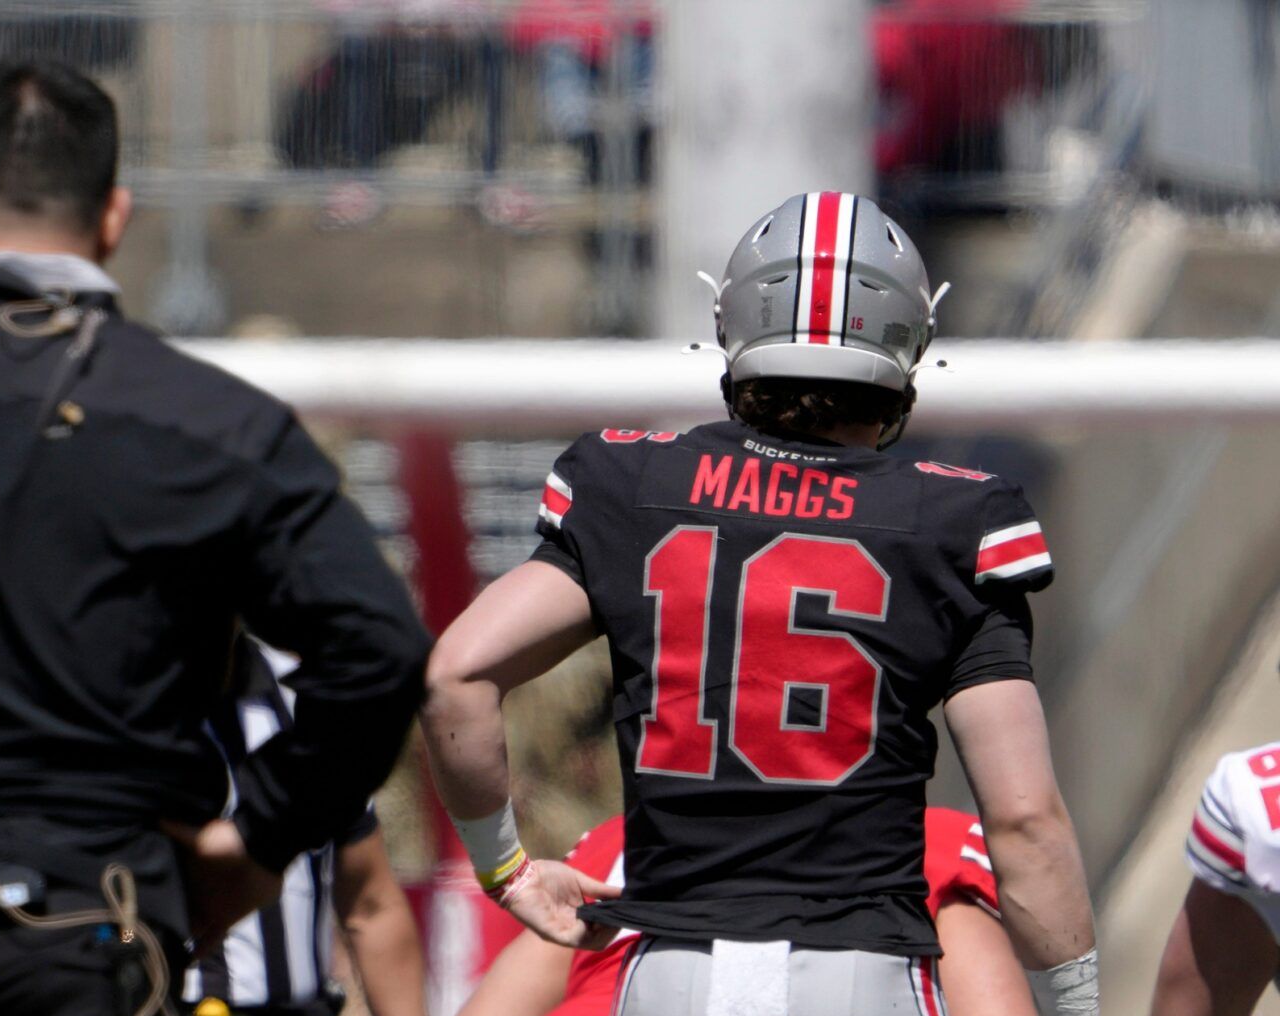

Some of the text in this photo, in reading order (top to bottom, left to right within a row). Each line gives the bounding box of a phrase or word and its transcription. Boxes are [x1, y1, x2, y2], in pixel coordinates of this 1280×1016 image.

[850, 316, 864, 330] 16
[743, 439, 838, 462] BUCKE
[689, 454, 859, 520] MAGGS
[634, 524, 892, 787] 16
